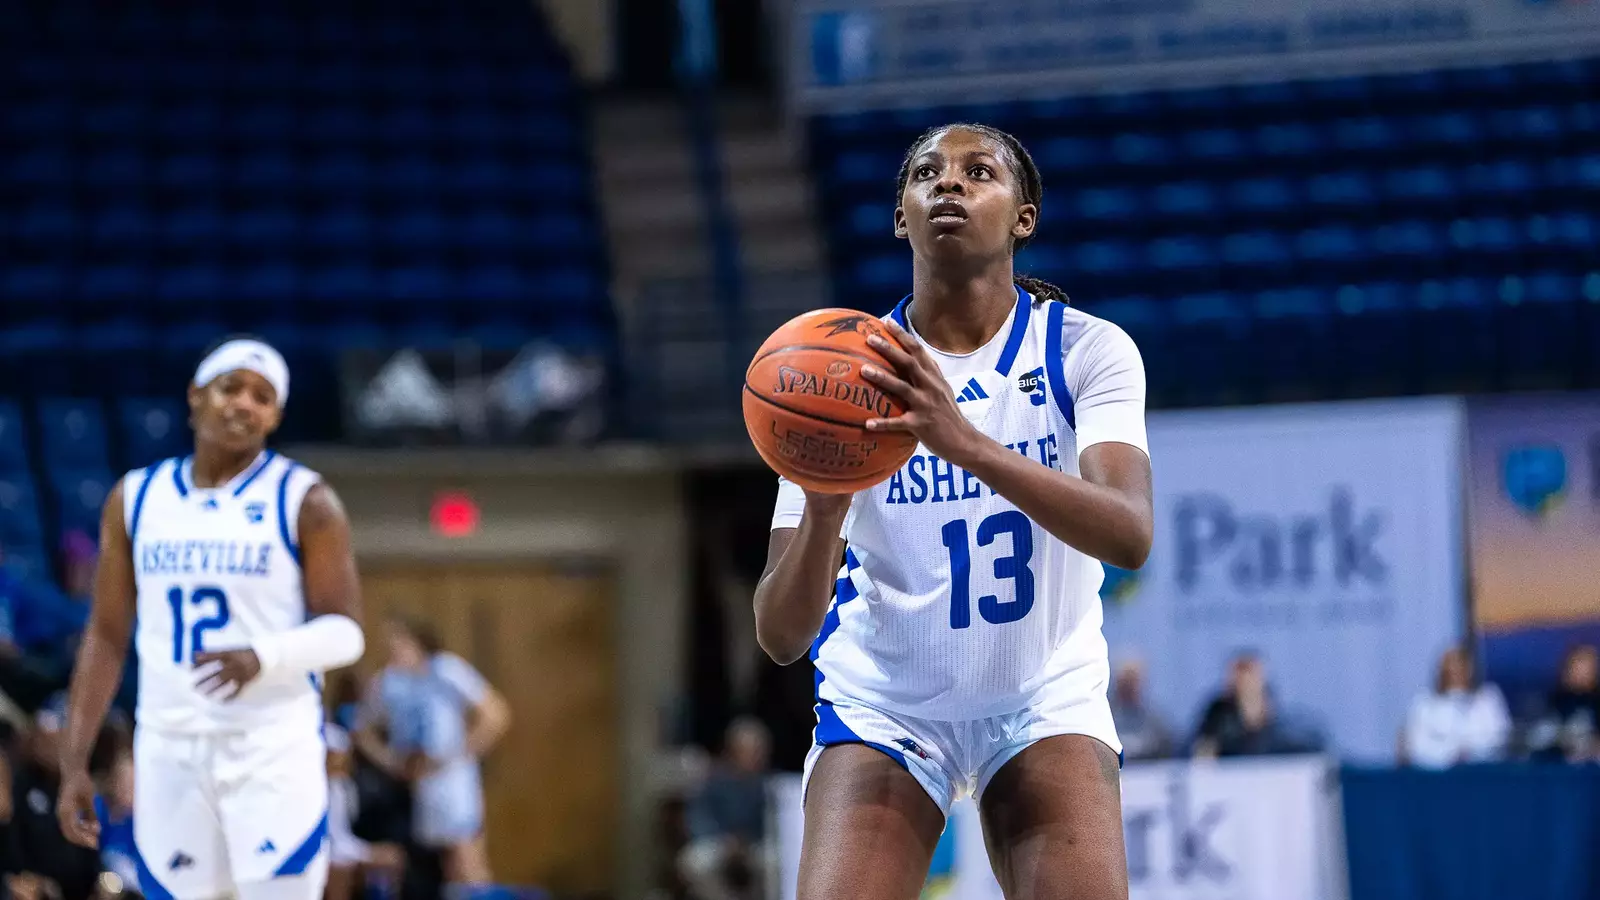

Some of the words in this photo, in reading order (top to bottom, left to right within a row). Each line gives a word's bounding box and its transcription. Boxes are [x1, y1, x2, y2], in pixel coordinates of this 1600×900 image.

[773, 365, 892, 418] SPALDING
[1018, 377, 1038, 388] BIG
[771, 419, 878, 459] LEGACY
[886, 433, 1063, 504] ASHEE
[941, 511, 1035, 629] 13
[1173, 482, 1390, 593] Park
[168, 586, 229, 664] 12
[1123, 780, 1234, 885] rk
